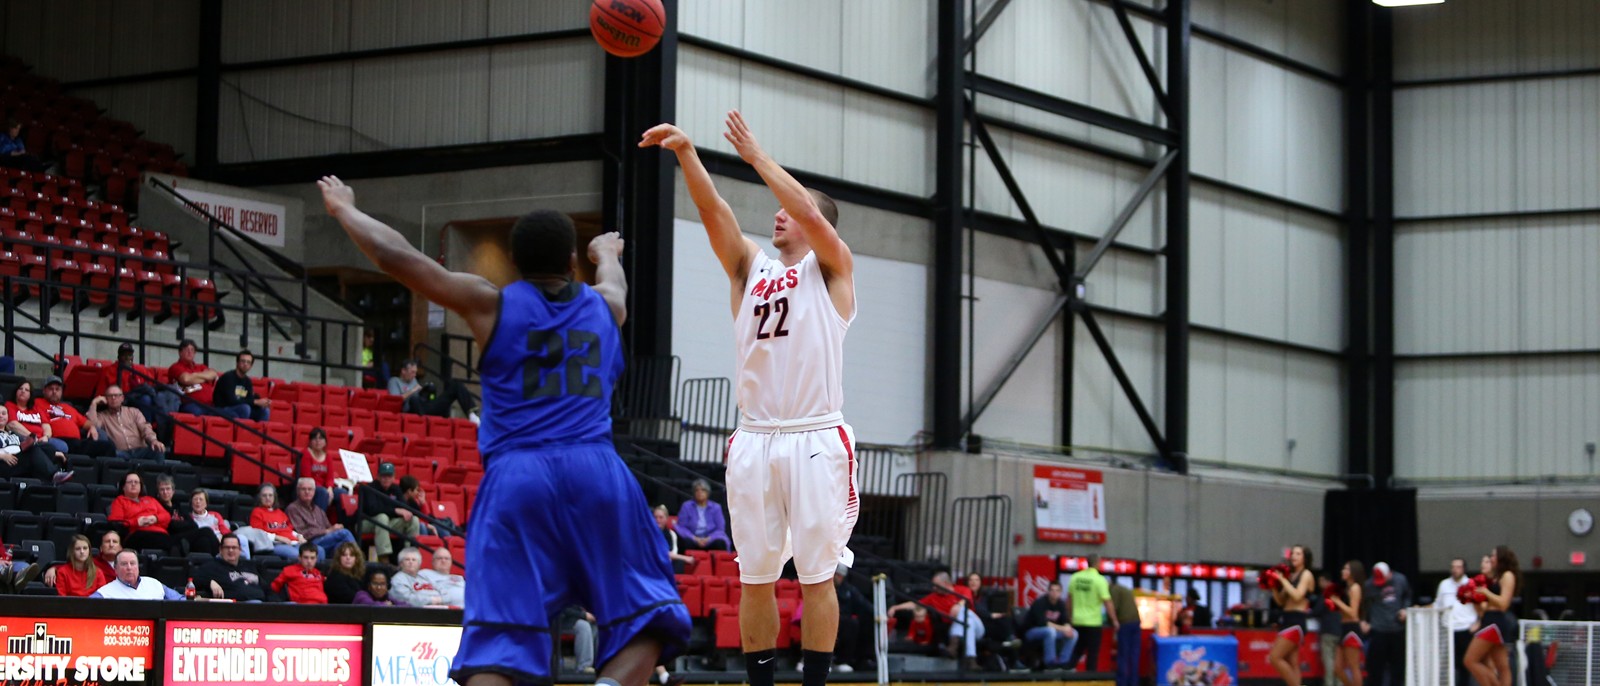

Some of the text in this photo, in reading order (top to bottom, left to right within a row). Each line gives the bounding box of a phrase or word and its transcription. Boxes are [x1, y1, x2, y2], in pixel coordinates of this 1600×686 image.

[597, 15, 642, 48] Wilson
[240, 209, 278, 237] RESERVED
[753, 296, 789, 340] 22
[522, 329, 603, 400] 22
[104, 624, 150, 635] 660-543-4370
[104, 636, 150, 646] 800-330-7698
[173, 628, 259, 645] UCM OFFICE OF
[74, 655, 146, 682] STORE
[172, 647, 350, 682] EXTENDED STUDIES
[373, 655, 418, 685] MFA
